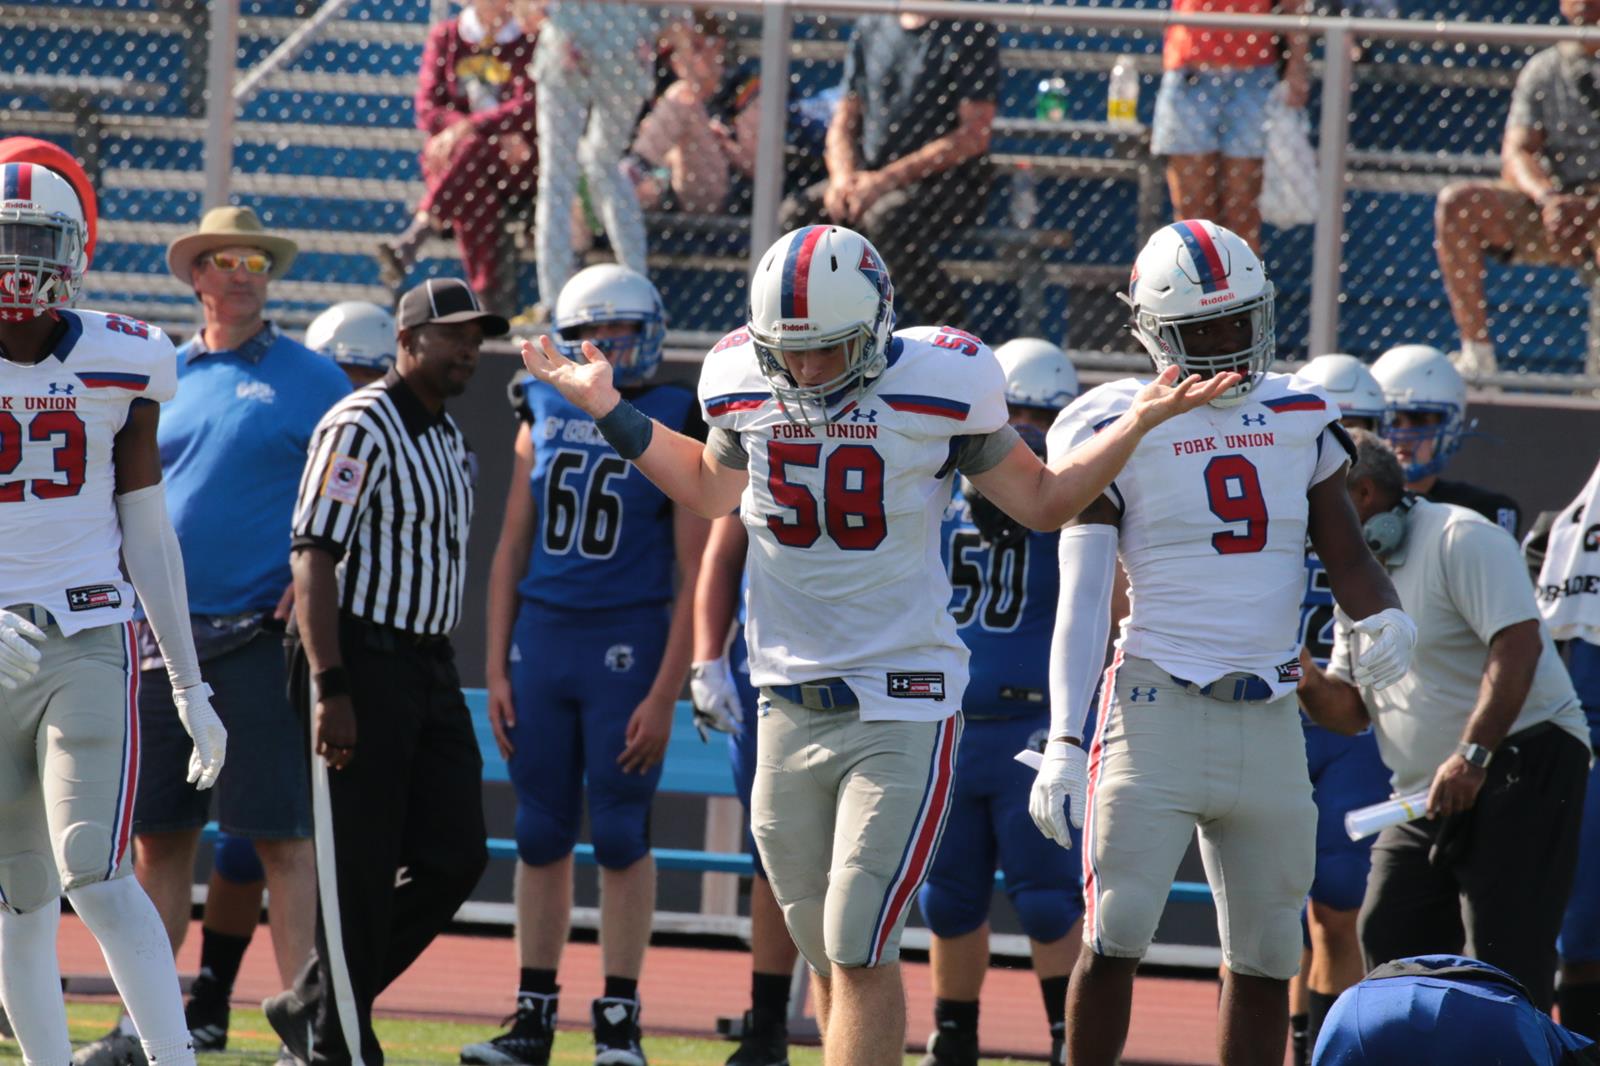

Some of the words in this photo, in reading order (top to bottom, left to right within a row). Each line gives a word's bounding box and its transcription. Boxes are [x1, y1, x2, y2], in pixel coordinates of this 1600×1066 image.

[1201, 293, 1235, 306] Riddell
[782, 323, 810, 331] Riddell
[24, 397, 77, 410] UNION
[772, 424, 815, 439] FORK
[826, 424, 878, 439] UNION
[1173, 437, 1217, 456] FORK
[1225, 432, 1275, 449] UNION
[542, 448, 631, 560] 66
[766, 440, 888, 550] 58
[1203, 453, 1269, 555] 9
[948, 528, 1029, 632] 50
